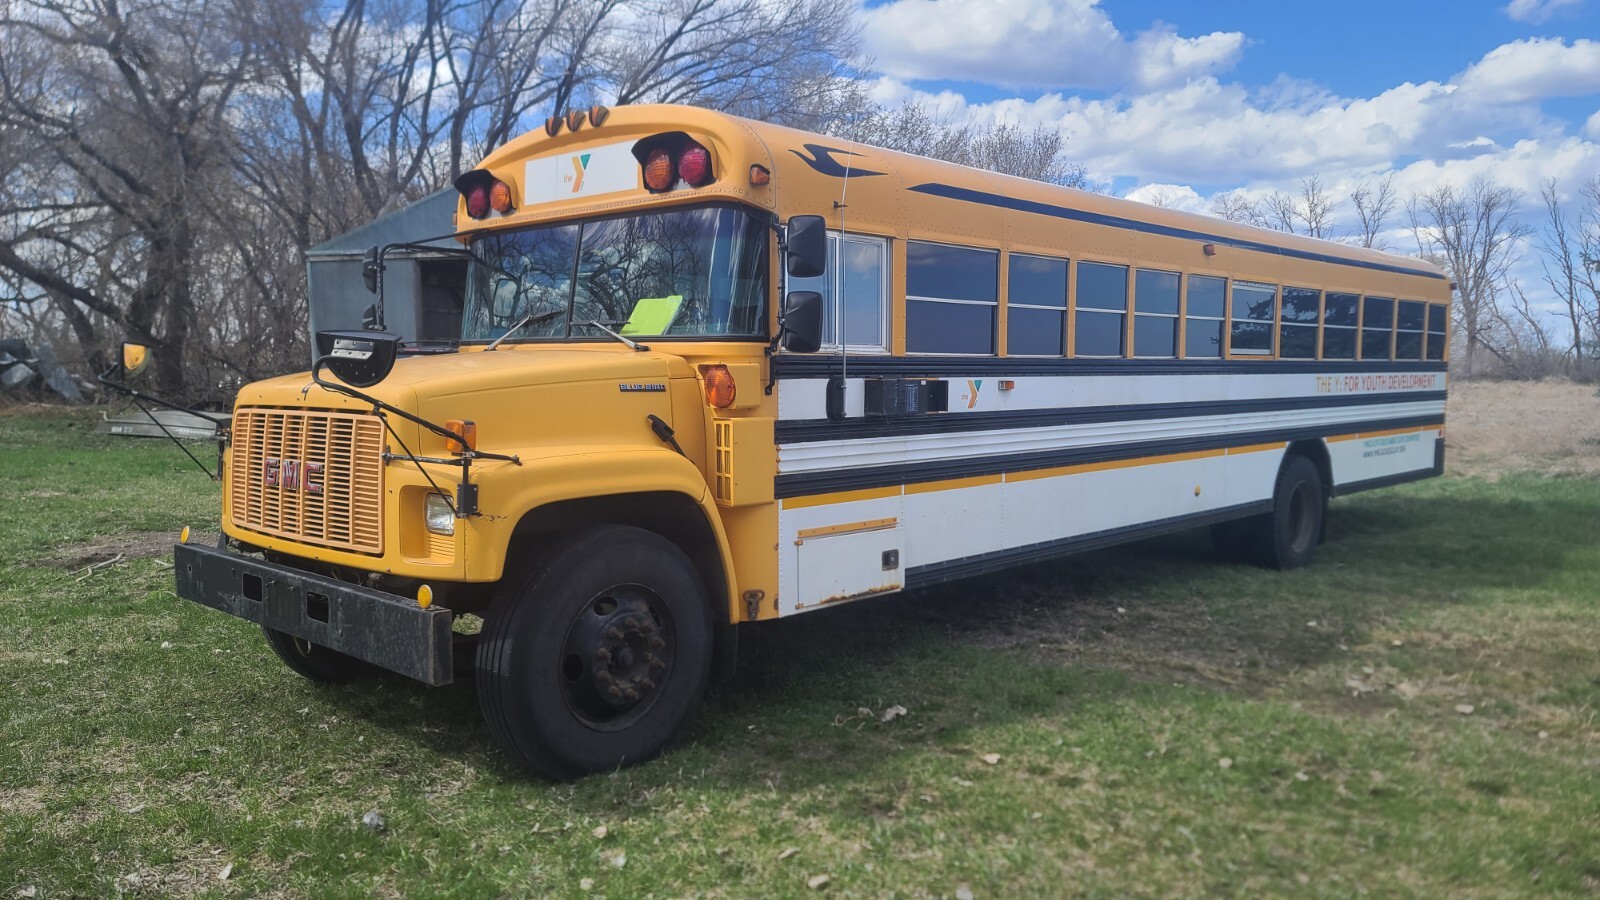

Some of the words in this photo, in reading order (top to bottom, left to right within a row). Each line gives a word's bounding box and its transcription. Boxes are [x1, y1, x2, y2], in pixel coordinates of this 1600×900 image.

[620, 383, 644, 391] BLUE
[645, 383, 666, 391] BIRD
[1316, 376, 1332, 392] THE
[1344, 375, 1359, 391] FOR
[1362, 375, 1387, 391] YOUTH
[1388, 374, 1436, 389] DEVELOPMENT
[264, 459, 323, 493] GMC
